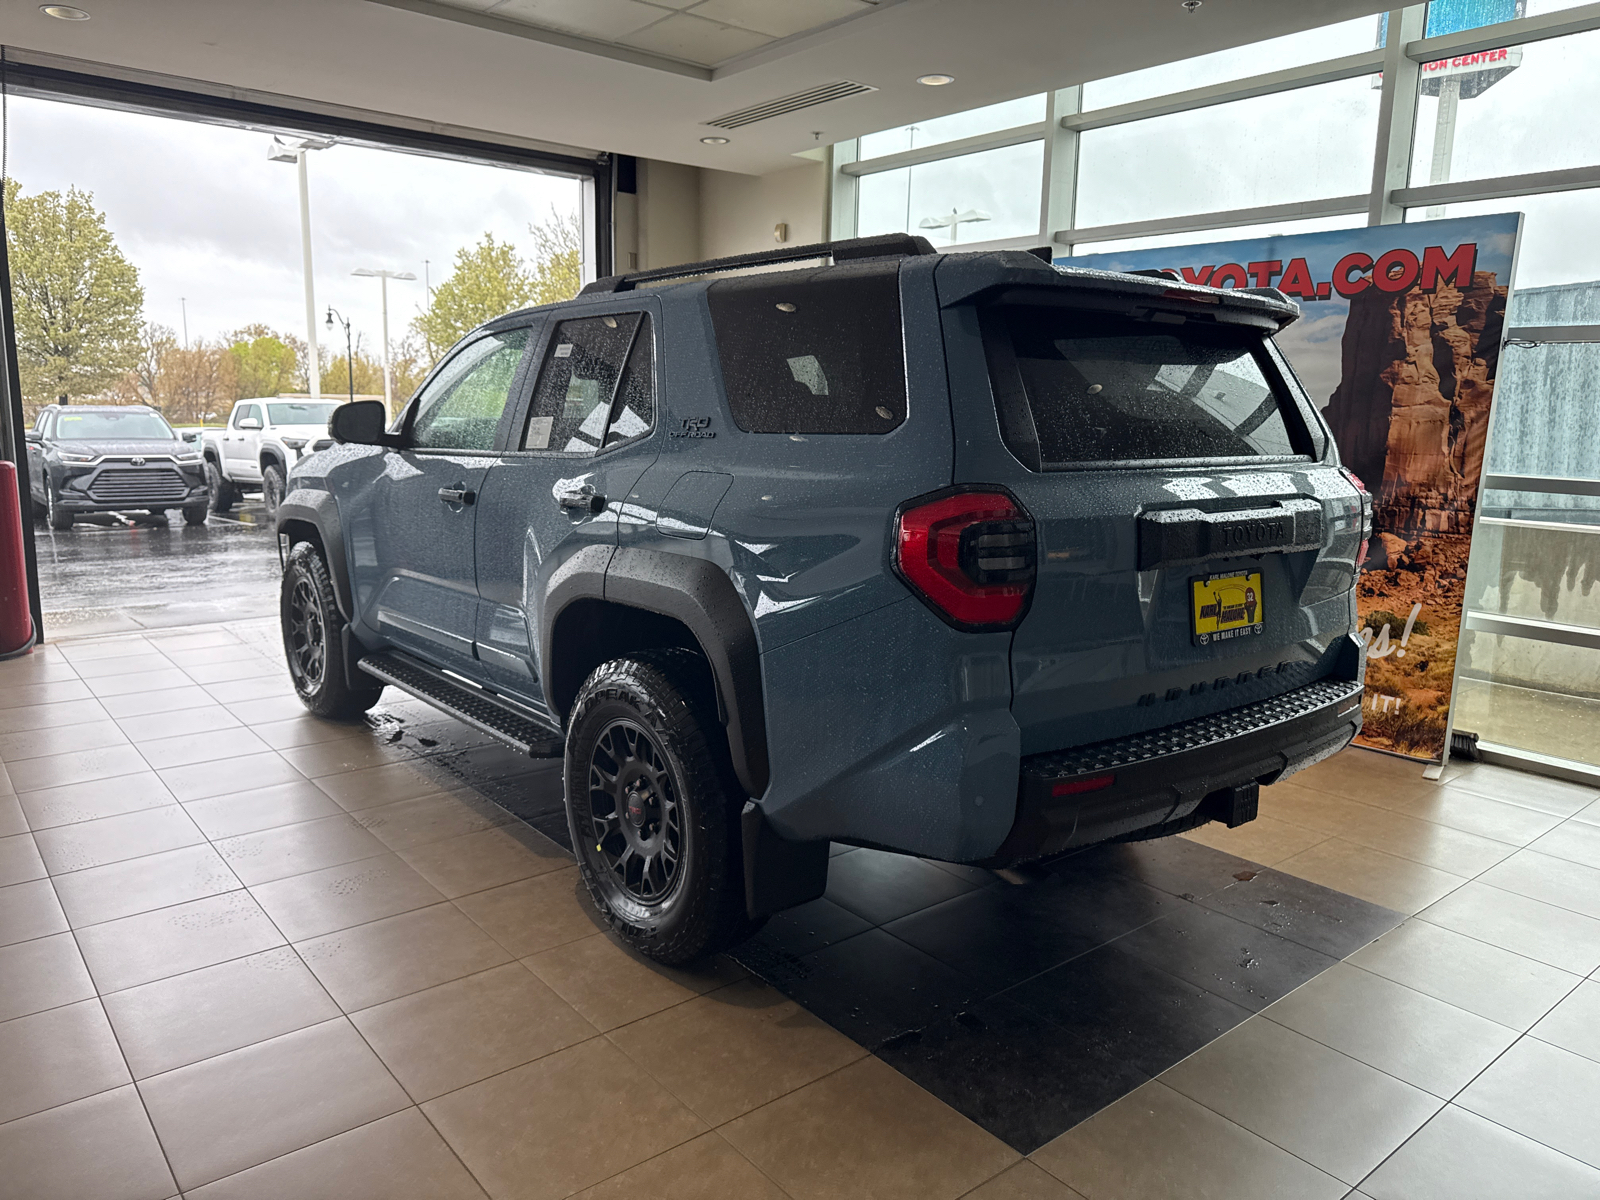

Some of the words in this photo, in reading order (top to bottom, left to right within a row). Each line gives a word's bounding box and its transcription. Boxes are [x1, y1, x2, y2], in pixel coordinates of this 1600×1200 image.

[1452, 48, 1508, 68] CENTER
[1223, 521, 1284, 546] TOYOTA
[1246, 592, 1254, 602] 32
[1212, 632, 1221, 642] WE
[1221, 629, 1234, 641] MAKE
[1234, 628, 1239, 638] IT
[1240, 626, 1251, 637] EASY
[1371, 693, 1402, 715] IT!
